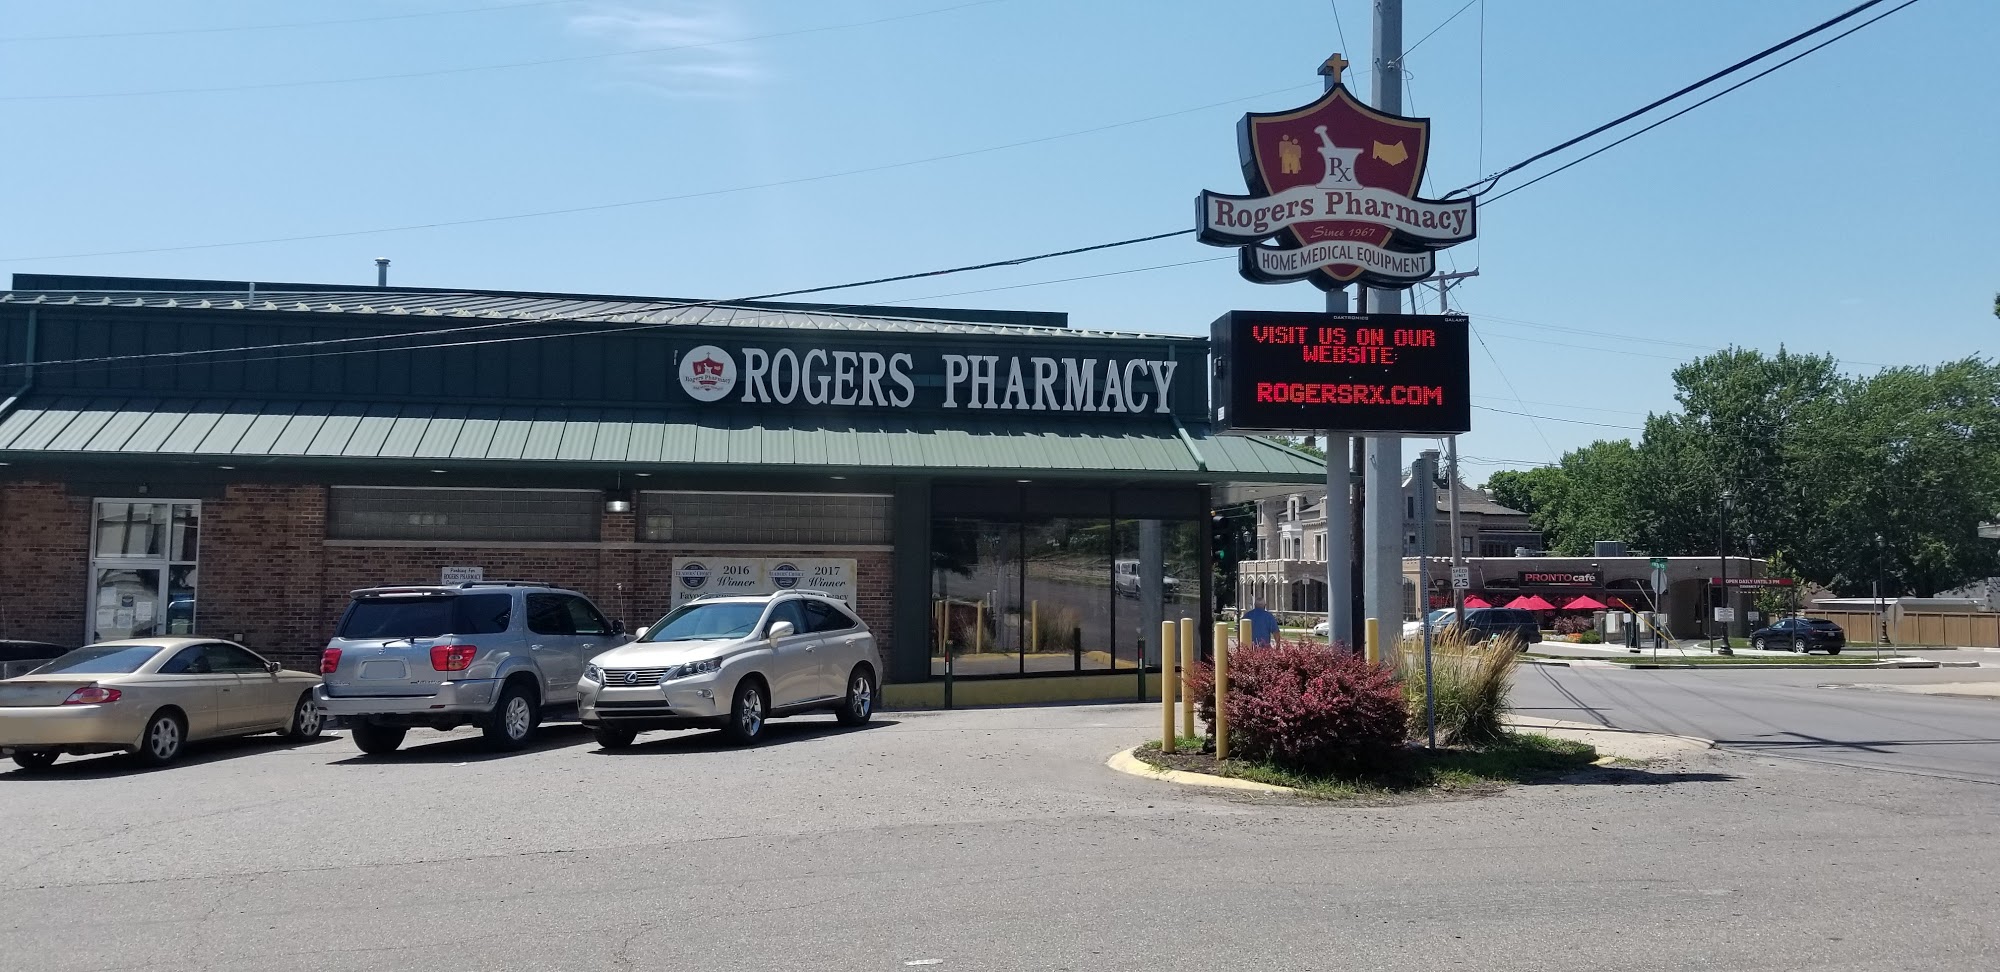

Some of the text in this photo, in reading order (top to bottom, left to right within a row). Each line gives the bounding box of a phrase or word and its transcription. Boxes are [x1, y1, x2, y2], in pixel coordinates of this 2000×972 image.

[1214, 191, 1467, 235] Rogers Pharmacy
[1310, 226, 1375, 239] Since 1967
[1262, 245, 1426, 273] HOME MEDICAL EQUIPMENT
[1252, 325, 1436, 347] VISIT US ON OUR
[740, 347, 1179, 414] ROGERS PHARMACY
[1257, 382, 1443, 406] ROGERSRX.COM
[723, 565, 750, 575] 2016
[814, 566, 841, 576] 2017
[716, 576, 756, 587] Winner
[808, 576, 846, 587] Winner
[1453, 578, 1469, 587] 25
[1525, 572, 1596, 582] PRONTO café
